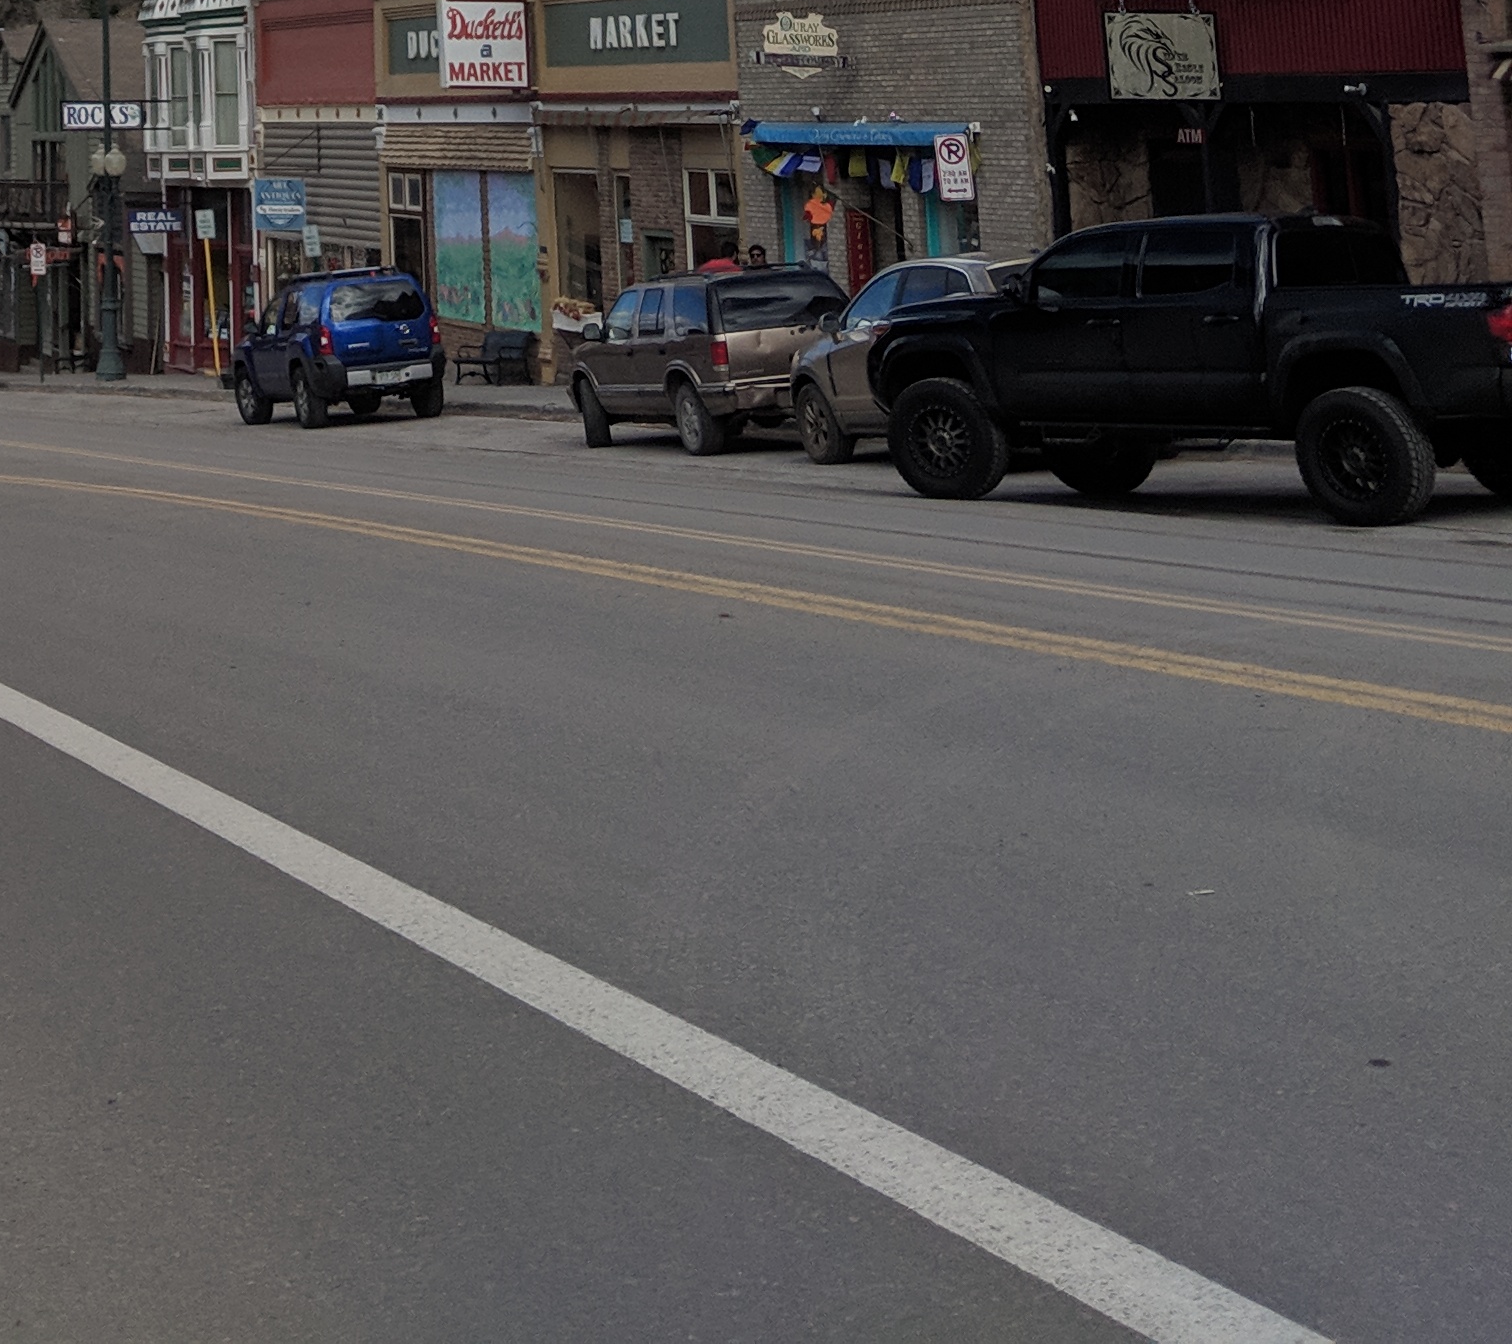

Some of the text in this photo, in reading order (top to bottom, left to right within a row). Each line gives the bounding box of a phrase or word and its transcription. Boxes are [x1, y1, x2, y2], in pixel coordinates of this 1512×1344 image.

[446, 7, 524, 41] Duckett's
[589, 12, 680, 50] MARKET
[766, 29, 835, 48] GLASSWORKS
[448, 62, 525, 82] MARKET
[1176, 128, 1203, 144] ATM
[135, 211, 177, 222] REAL
[129, 221, 183, 232] ESTATE
[1400, 293, 1445, 308] TRD
